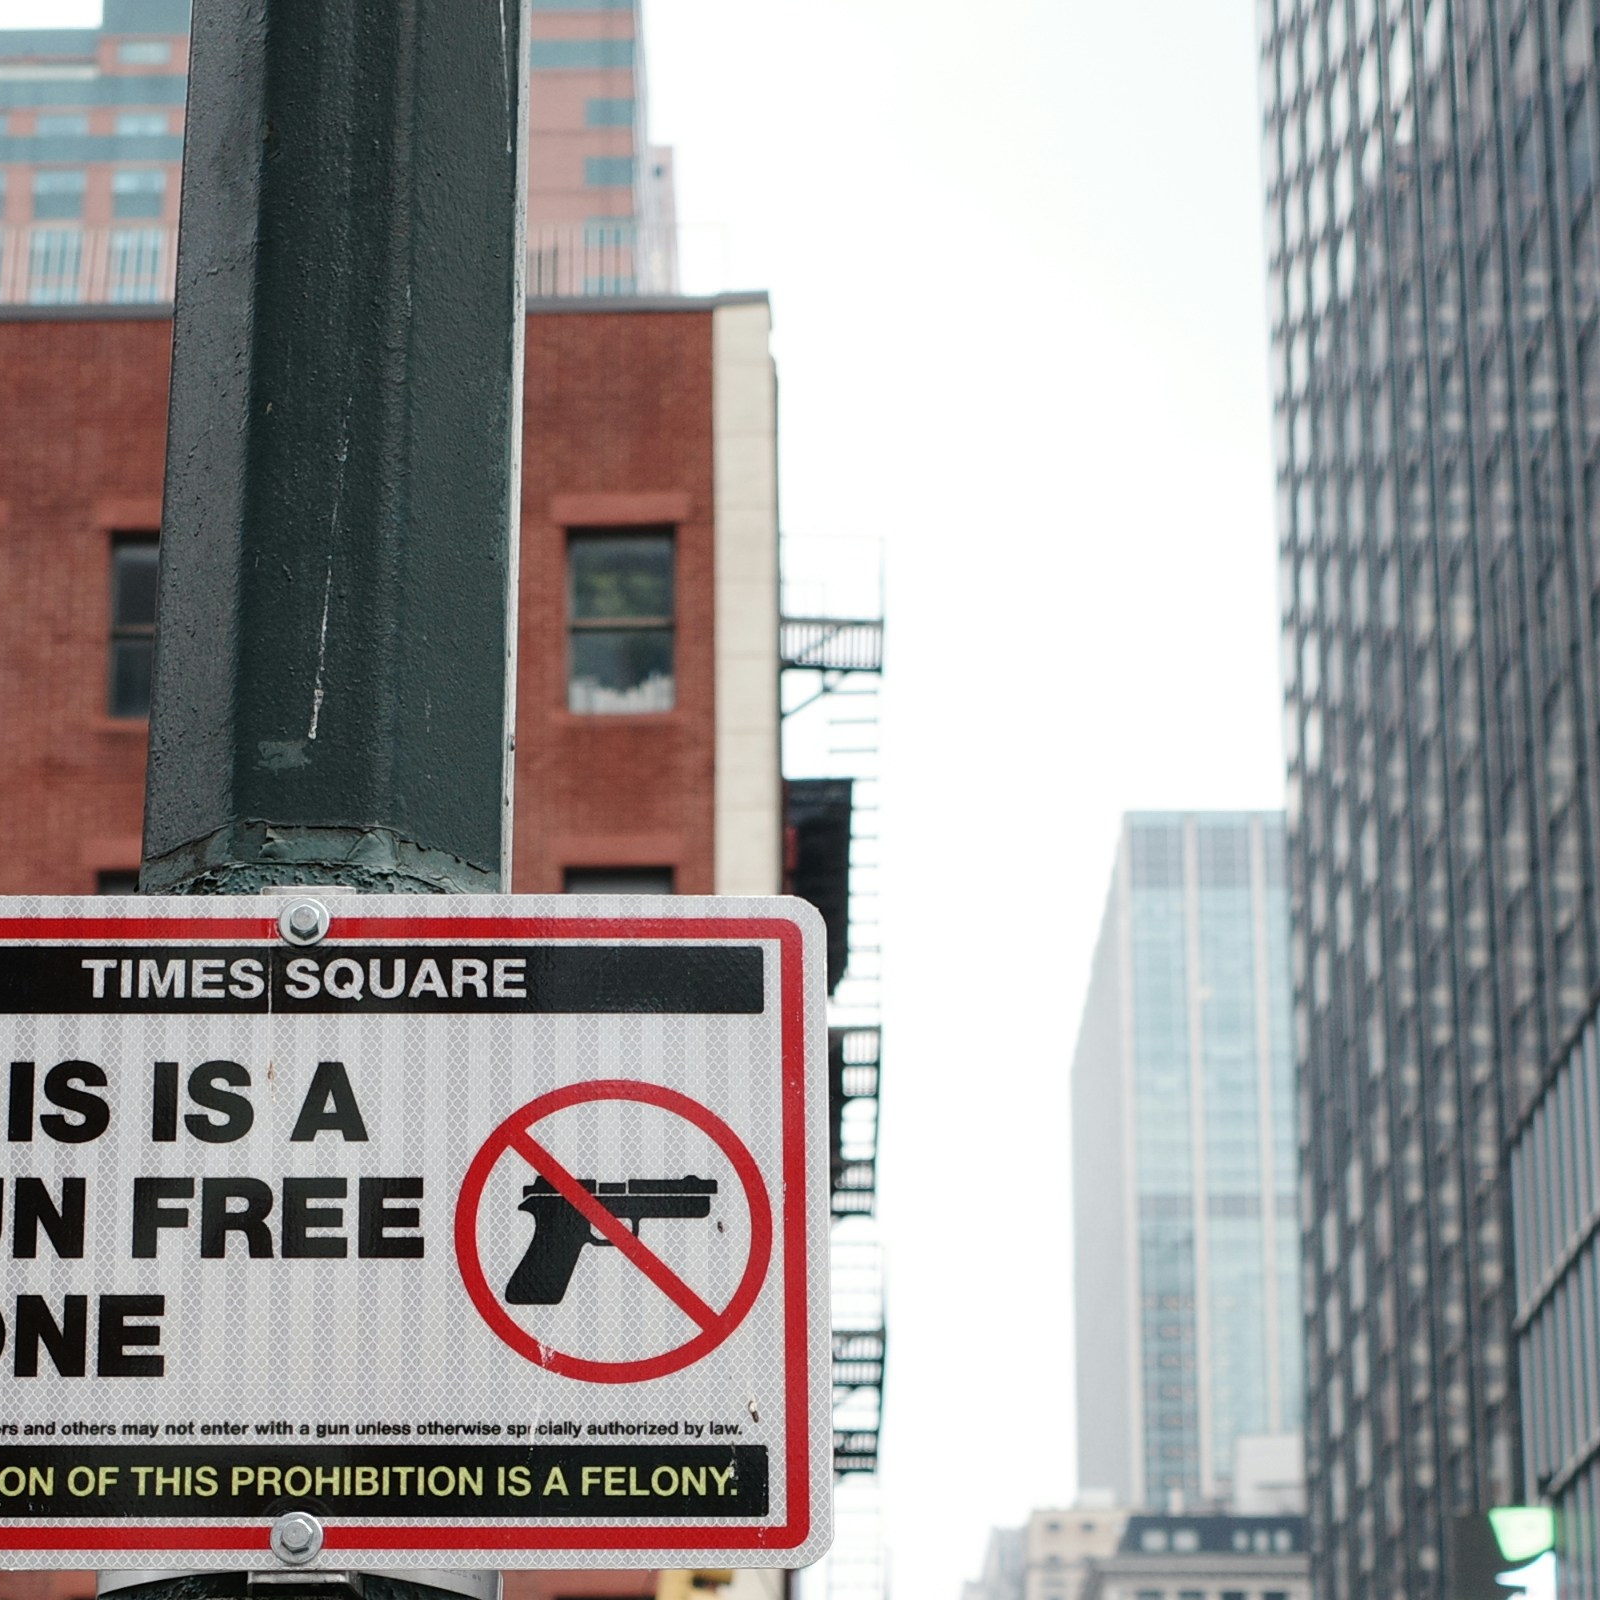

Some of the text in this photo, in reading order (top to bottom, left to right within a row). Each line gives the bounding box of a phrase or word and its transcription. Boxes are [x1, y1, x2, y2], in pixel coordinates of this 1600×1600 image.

[82, 958, 527, 1002] TIMES SQUARE
[152, 1060, 254, 1143] IS
[290, 1061, 369, 1142] A
[132, 1177, 424, 1259] FREE
[24, 1421, 55, 1437] and
[61, 1421, 116, 1437] others
[122, 1425, 158, 1439] may
[165, 1421, 194, 1437] not
[201, 1421, 248, 1437] enter
[255, 1421, 293, 1437] with
[300, 1425, 309, 1437] a
[316, 1425, 349, 1439] gun
[355, 1421, 411, 1437] unless
[417, 1421, 501, 1437] otherwise
[587, 1421, 679, 1437] authorized
[684, 1421, 704, 1439] by
[710, 1421, 743, 1437] law.
[68, 1467, 119, 1496] OF
[131, 1467, 218, 1496] THIS
[232, 1467, 483, 1496] PROHIBITION
[498, 1467, 531, 1496] IS
[543, 1467, 569, 1496] A
[582, 1467, 738, 1496] FELONY.
